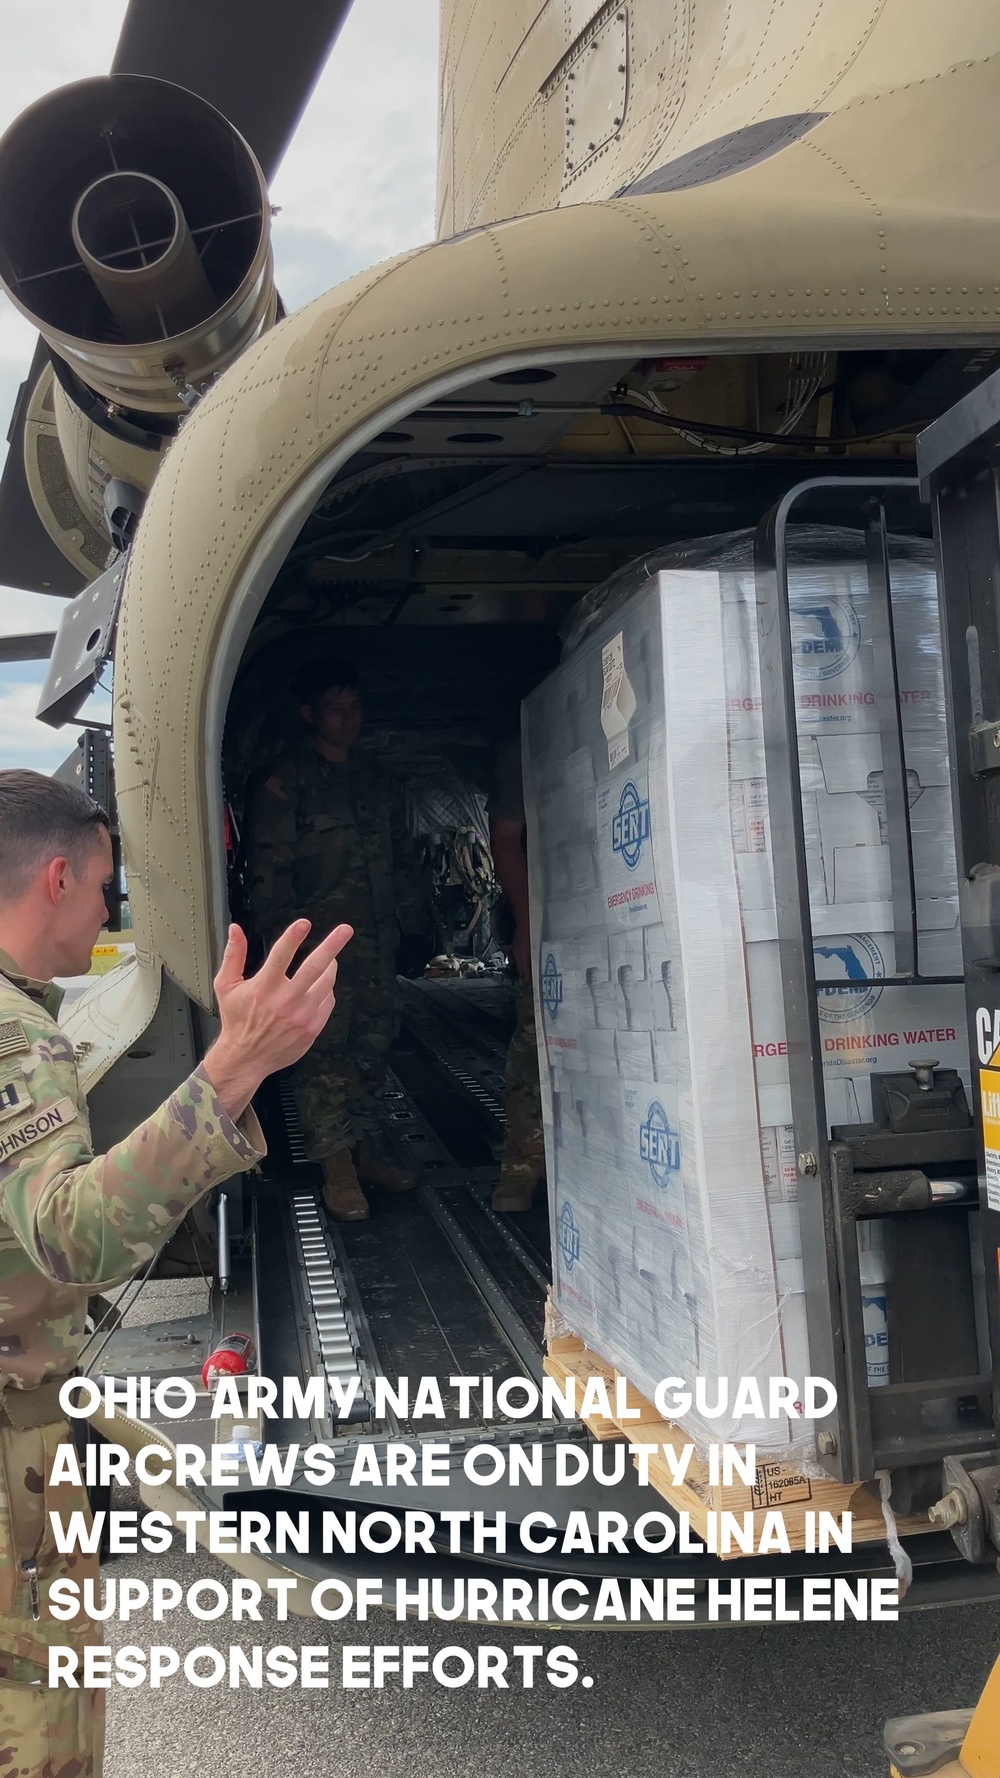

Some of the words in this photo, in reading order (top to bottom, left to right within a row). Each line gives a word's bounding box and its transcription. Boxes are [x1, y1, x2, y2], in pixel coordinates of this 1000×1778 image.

[824, 1032, 900, 1051] DRINKING
[902, 1028, 956, 1045] WATER
[822, 1056, 878, 1067] ridaDisaster.org
[769, 1491, 783, 1502] HT
